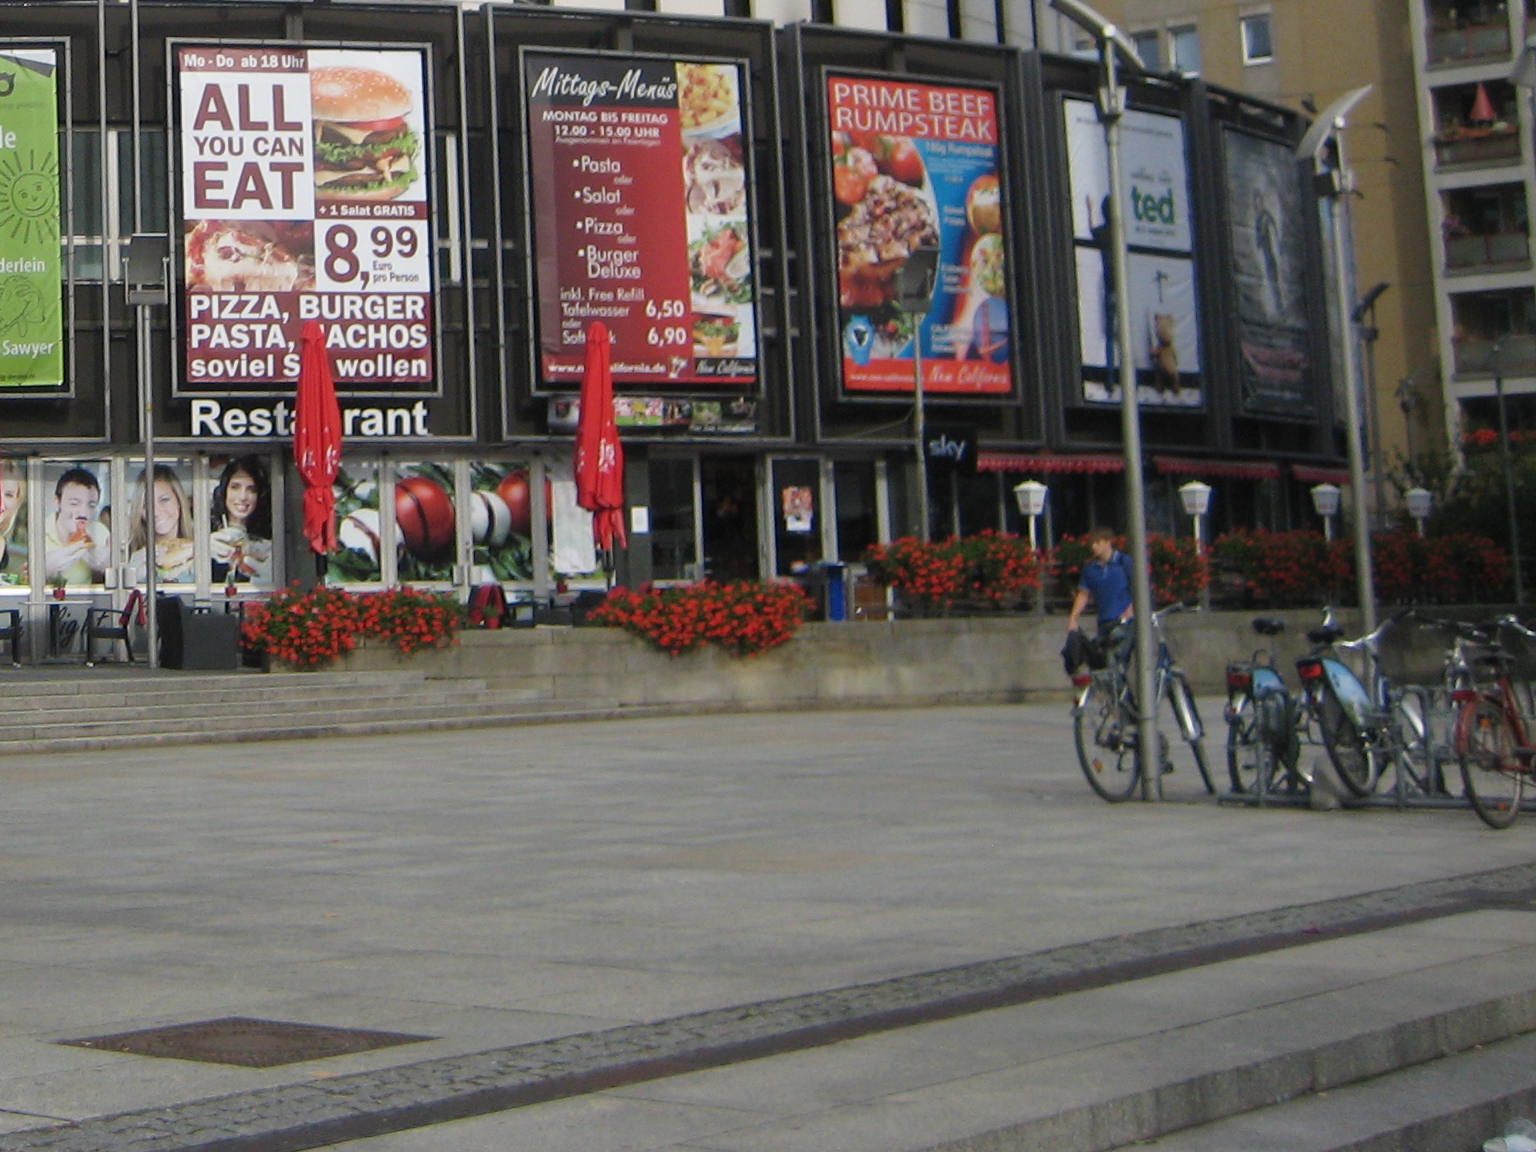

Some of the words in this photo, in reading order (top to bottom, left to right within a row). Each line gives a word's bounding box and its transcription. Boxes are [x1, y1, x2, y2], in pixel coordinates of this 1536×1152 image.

[184, 54, 205, 69] Mo
[216, 54, 234, 69] Do
[240, 54, 258, 68] ab
[261, 54, 279, 68] 18
[281, 54, 305, 69] Uhr
[532, 66, 678, 107] Mittags-Menüs
[193, 83, 304, 132] ALL
[833, 82, 923, 112] PRIME
[928, 90, 991, 118] BEEF
[542, 110, 598, 123] MONTAG
[600, 111, 619, 123] BIS
[621, 111, 669, 125] FREITAG
[835, 106, 994, 141] RUMPSTEAK
[554, 124, 588, 136] 12.00
[599, 125, 632, 138] 15.00
[634, 127, 660, 139] UHR
[194, 135, 244, 157] YOU
[253, 136, 304, 157] CAN
[581, 154, 621, 174] Pasta
[193, 161, 305, 210] EAT
[613, 174, 633, 185] oder
[582, 185, 621, 204] Salat
[329, 204, 339, 216] 1
[340, 204, 371, 217] Salat
[373, 205, 416, 217] GRATIS
[615, 204, 636, 216] oder
[1130, 184, 1176, 226] ted
[584, 216, 624, 235] Pizza
[617, 233, 637, 244] oder
[372, 260, 393, 271] Euro
[586, 244, 639, 267] Burger
[372, 273, 387, 283] pro
[389, 272, 420, 283] Person
[587, 261, 642, 279] Deluxe
[559, 287, 585, 301] inkl.
[588, 288, 614, 300] Free
[617, 287, 645, 300] Refill
[190, 294, 290, 324] PIZZA,
[299, 294, 425, 320] BURGER
[561, 303, 631, 318] Tafelwasser
[645, 299, 685, 319] 6,50
[191, 323, 296, 352] PASTA,
[319, 323, 428, 349] ACHOS
[647, 326, 687, 347] 6,90
[2, 339, 54, 359] Sawyer
[191, 352, 275, 377] soviel
[336, 353, 428, 377] wollen
[190, 399, 429, 436] Restrant
[928, 433, 968, 462] sky
